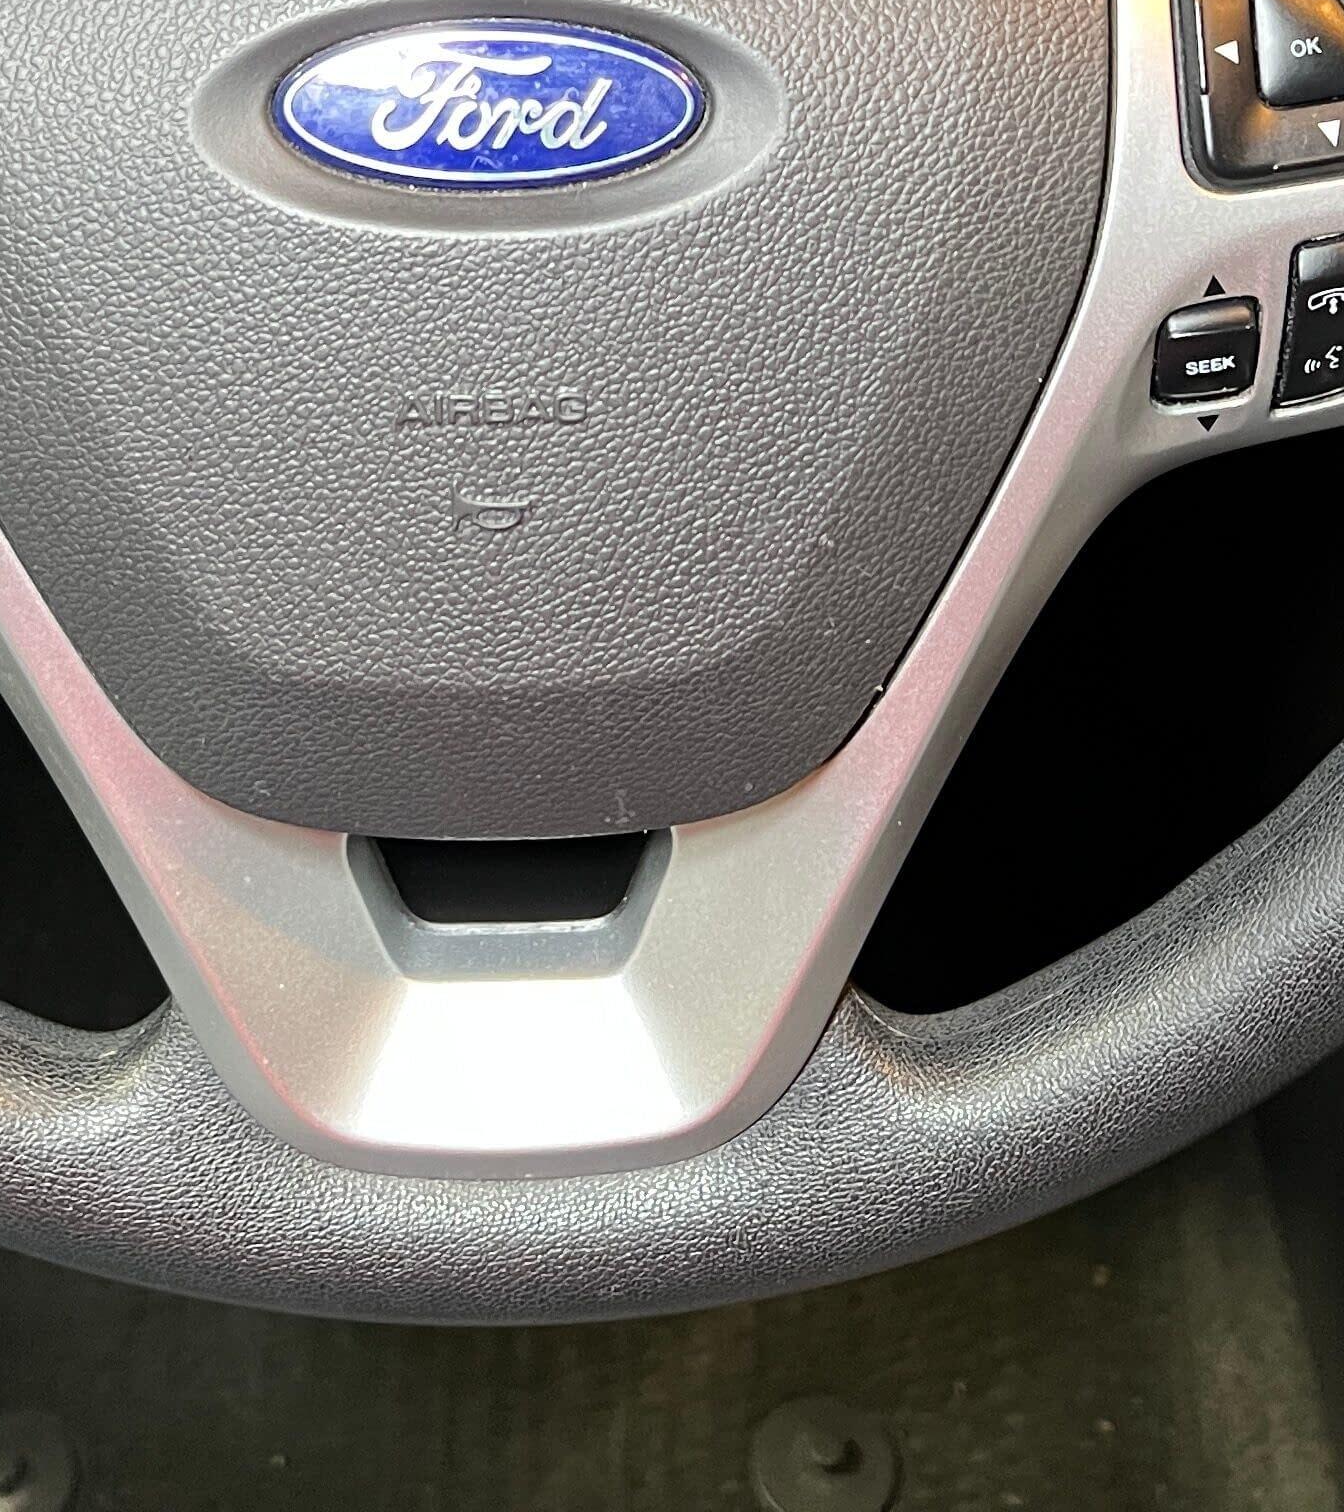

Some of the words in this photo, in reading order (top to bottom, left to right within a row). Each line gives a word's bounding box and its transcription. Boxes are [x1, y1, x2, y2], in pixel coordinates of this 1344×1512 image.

[1289, 35, 1323, 59] OK
[372, 50, 609, 150] Ford
[1185, 354, 1236, 376] SEEK
[398, 391, 590, 426] AIRBAG
